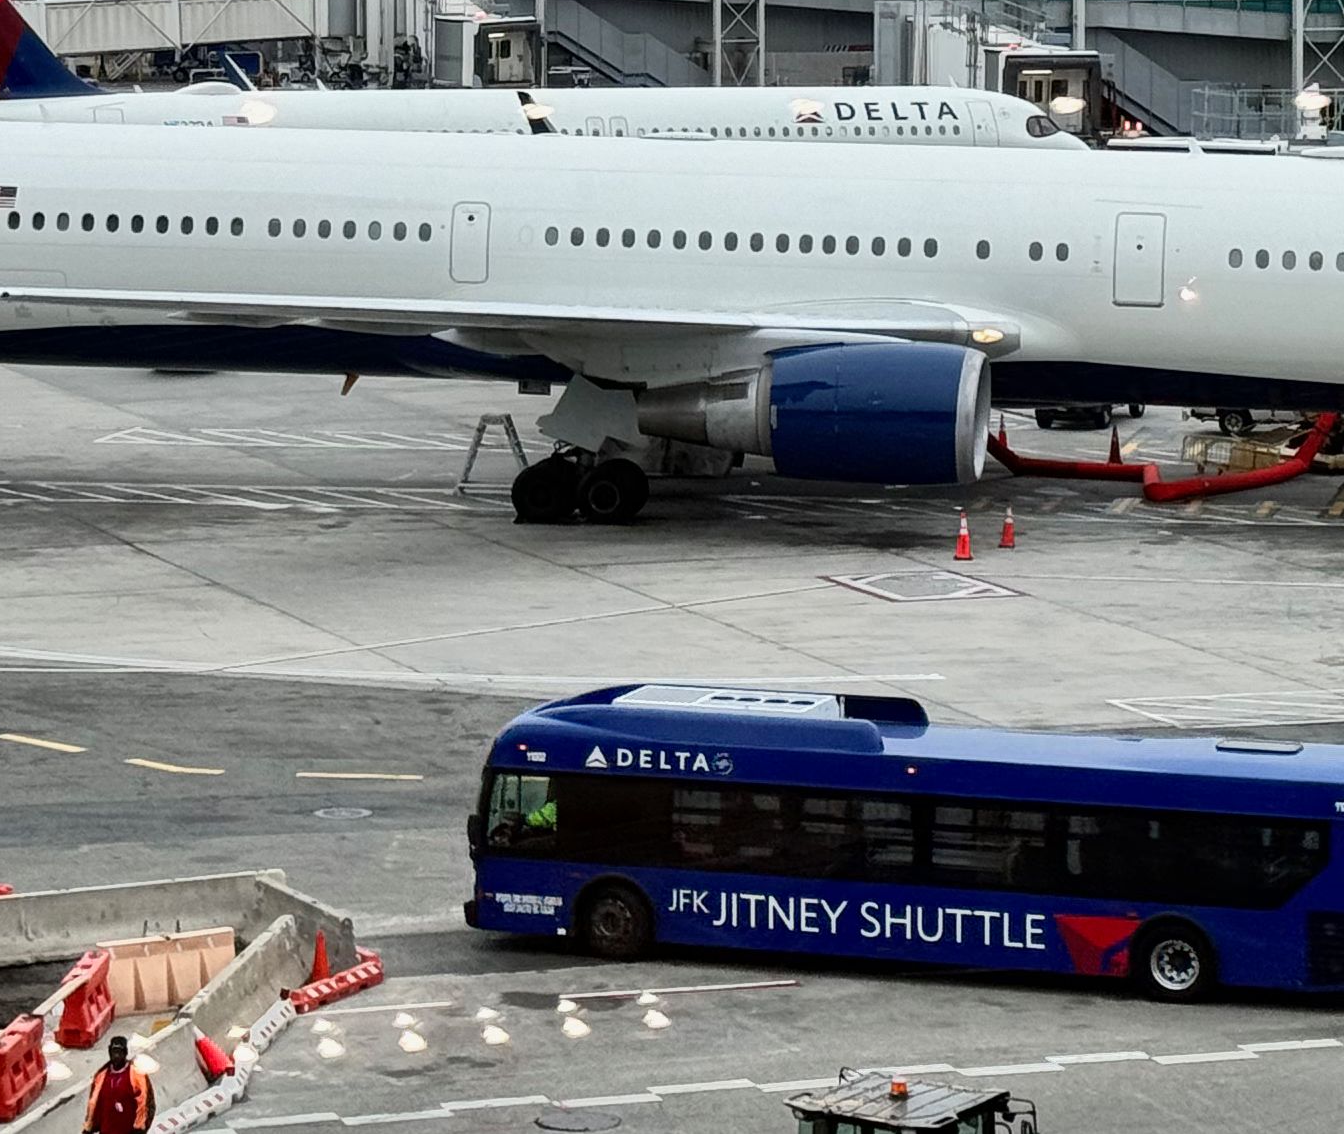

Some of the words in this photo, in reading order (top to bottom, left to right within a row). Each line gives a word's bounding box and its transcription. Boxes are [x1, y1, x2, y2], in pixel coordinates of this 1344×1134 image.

[834, 102, 959, 120] DELTA
[617, 748, 710, 772] DELTA
[668, 889, 710, 914] JFK
[713, 892, 848, 935] JITNEY
[860, 902, 1046, 950] SHUTTLE
